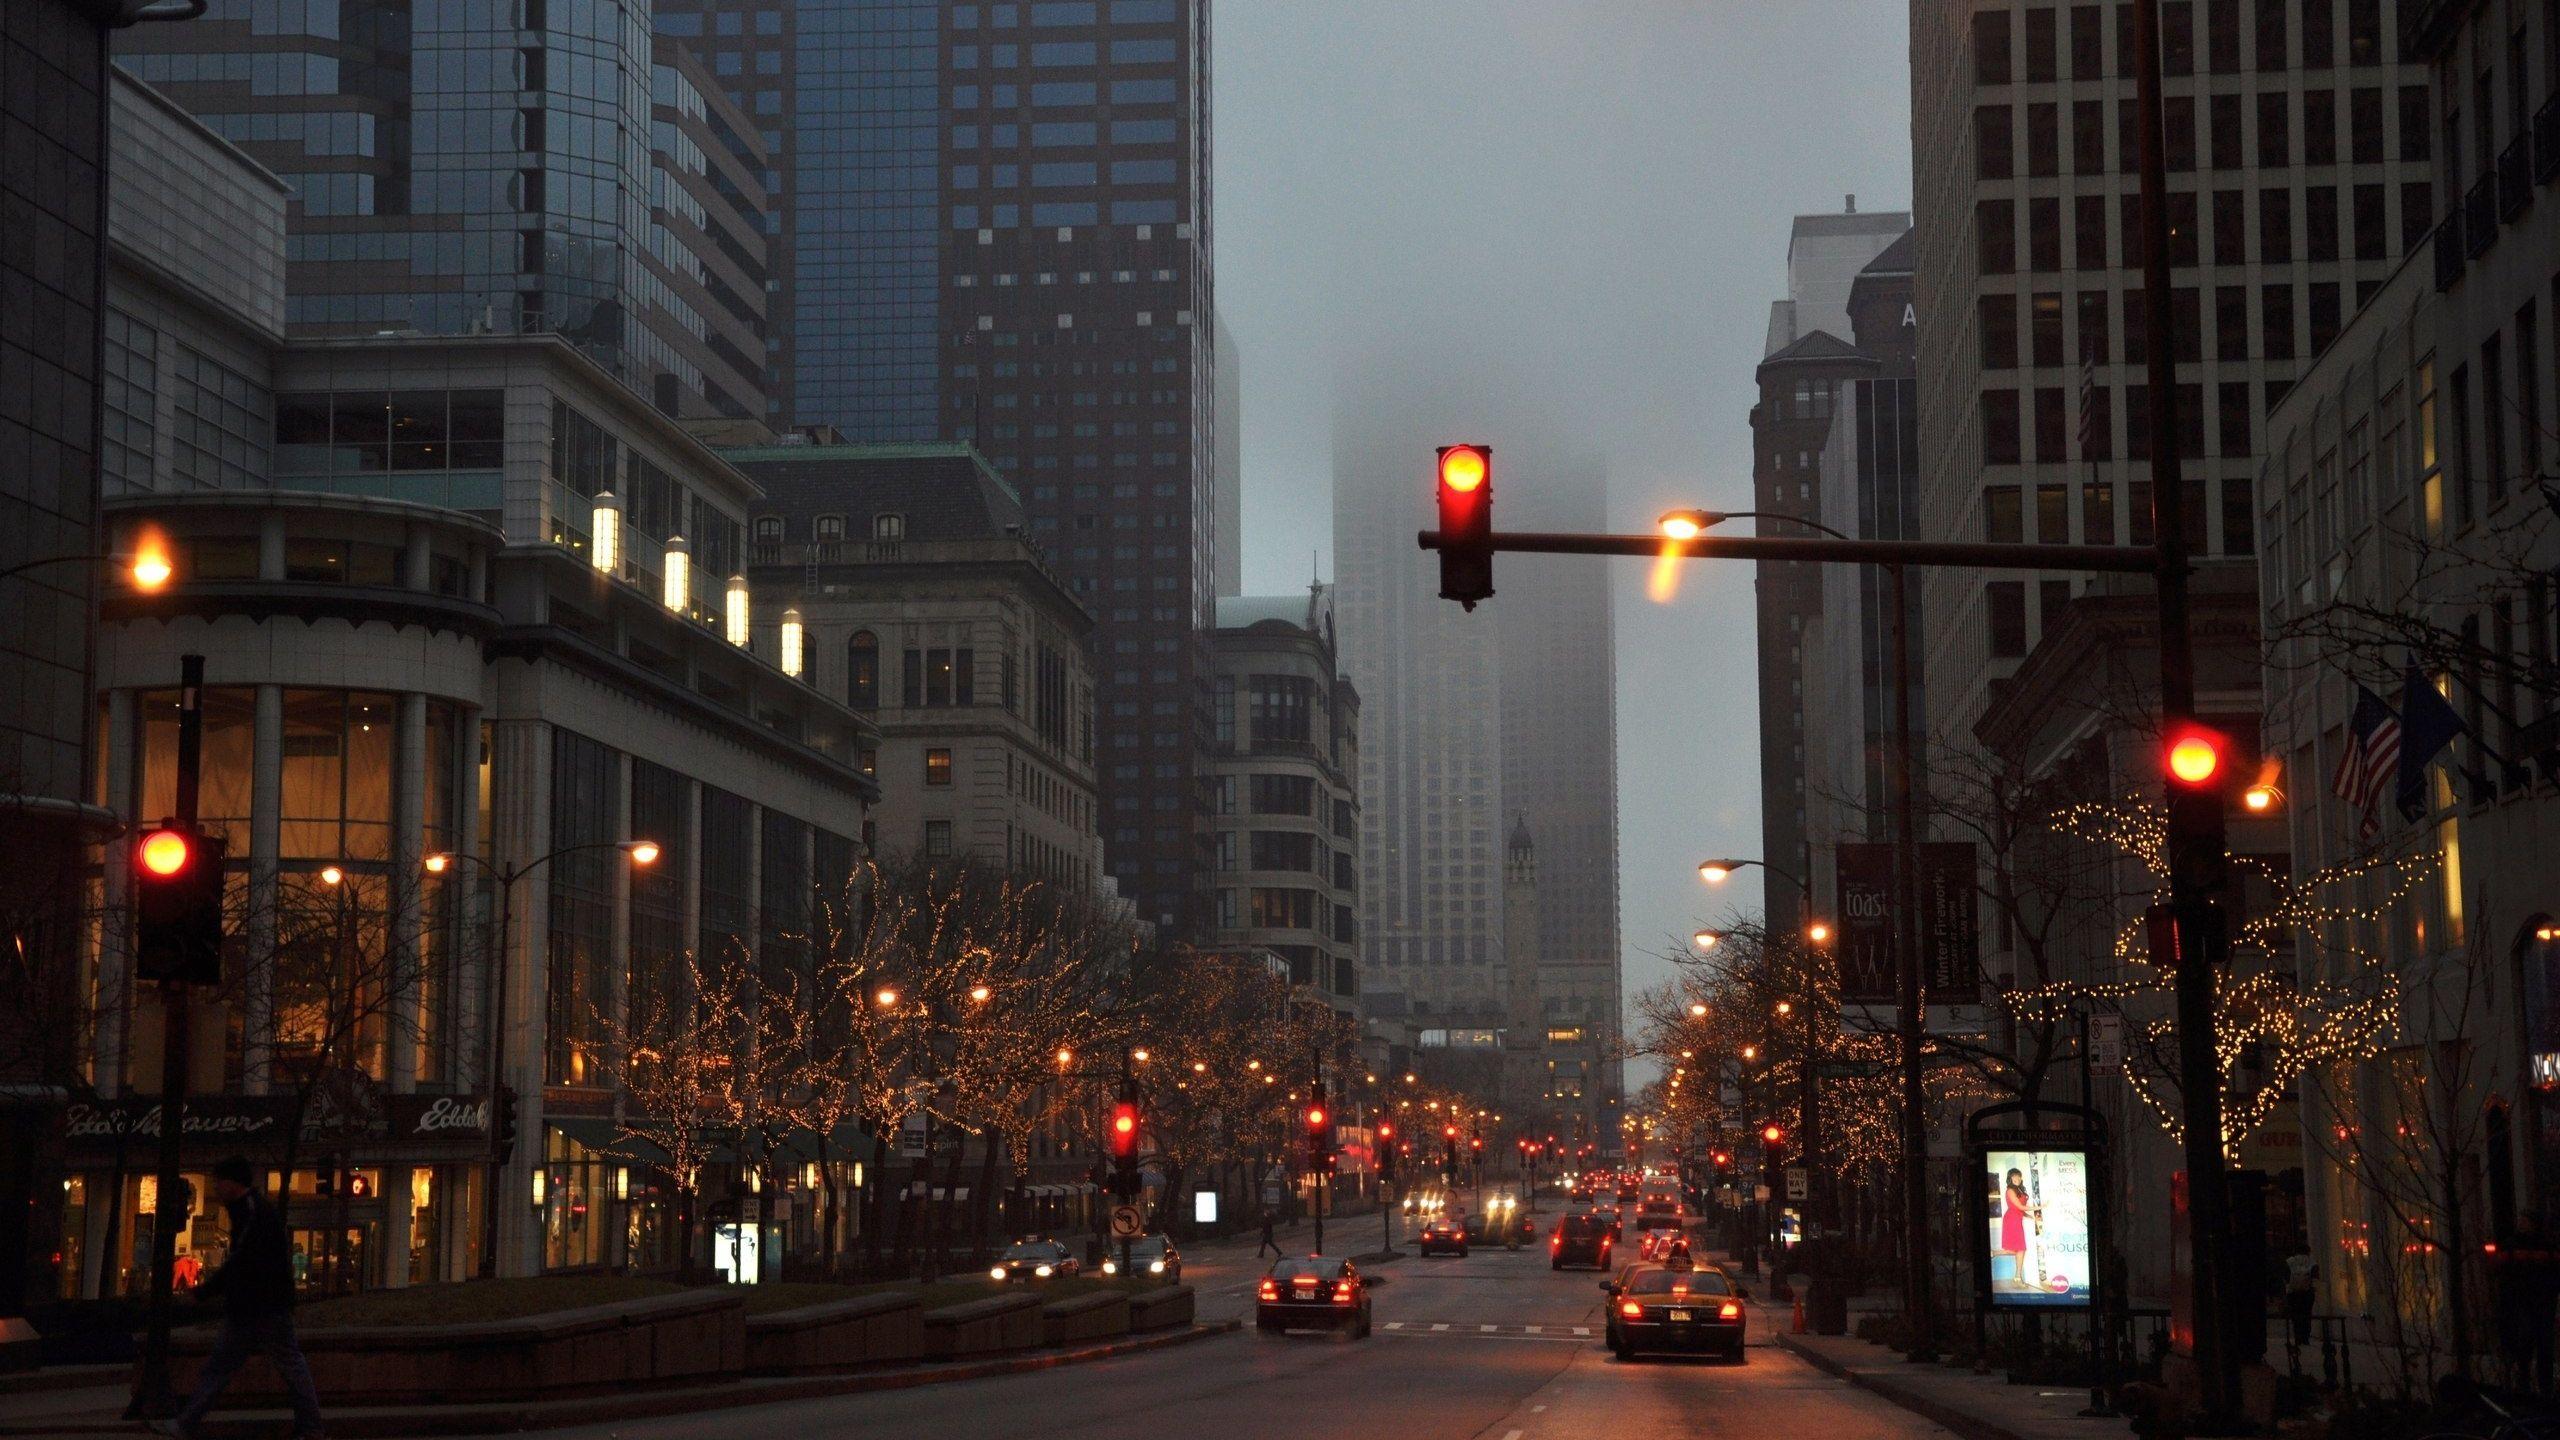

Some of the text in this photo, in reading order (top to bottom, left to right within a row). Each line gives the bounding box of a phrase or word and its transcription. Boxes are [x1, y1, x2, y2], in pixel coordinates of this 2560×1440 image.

[1845, 889, 1890, 917] toast
[1936, 937, 1950, 988] Winter
[1788, 1170, 1805, 1179] ONE
